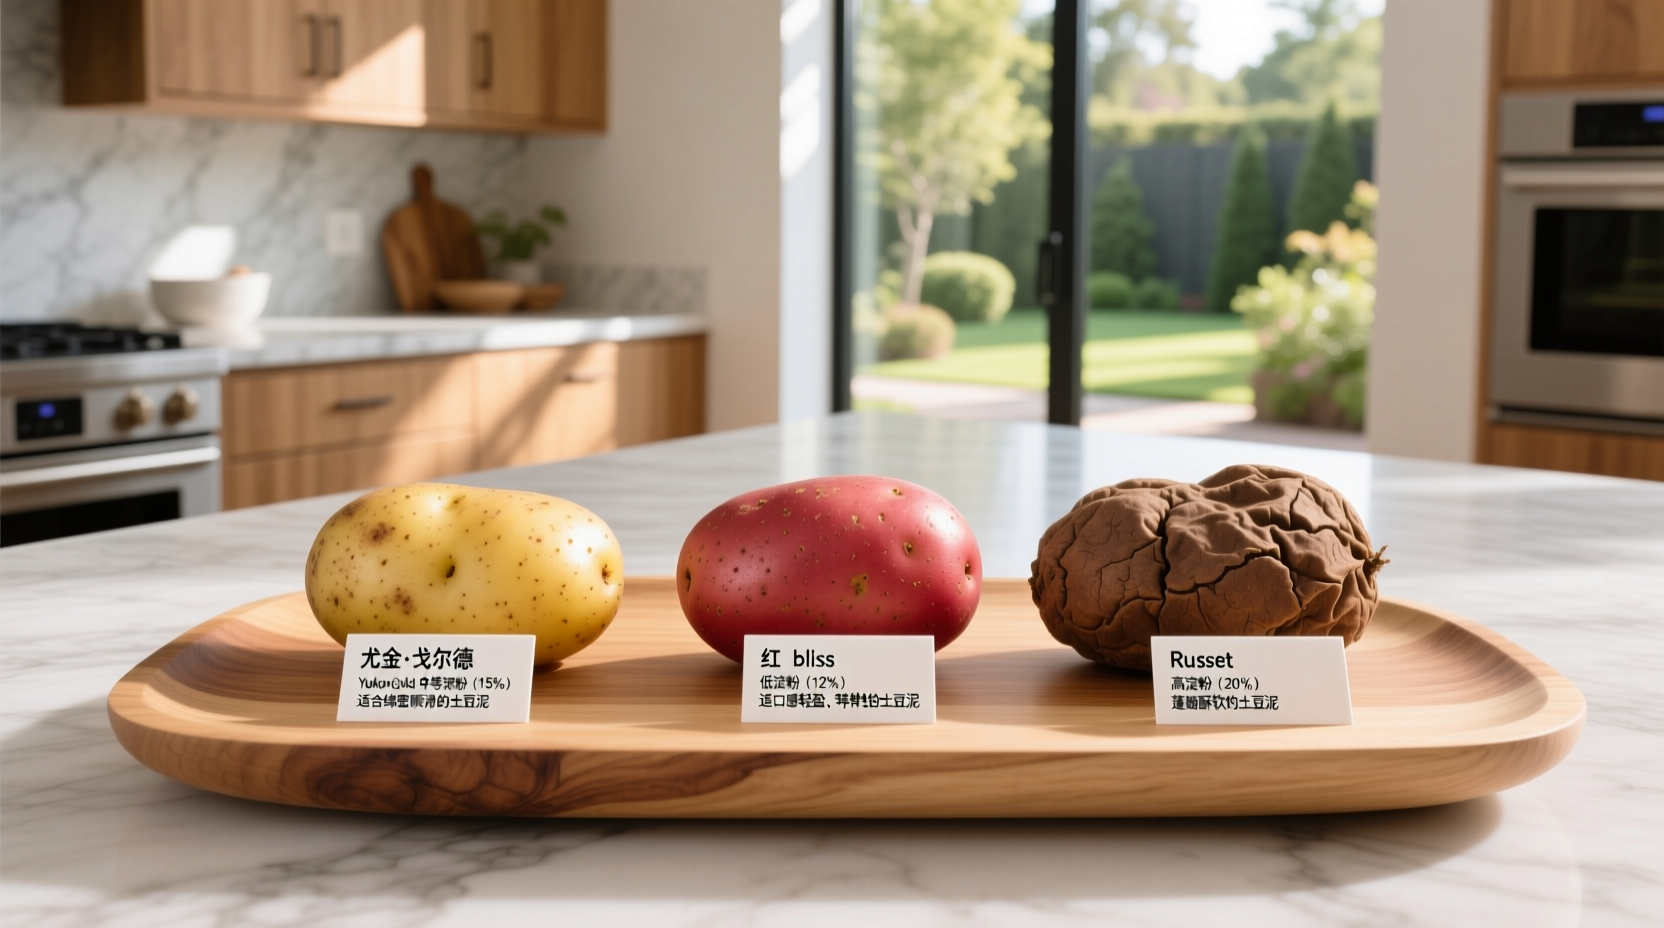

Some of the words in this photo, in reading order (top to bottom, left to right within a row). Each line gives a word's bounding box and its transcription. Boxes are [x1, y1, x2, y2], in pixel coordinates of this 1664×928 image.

[360, 646, 474, 671] 尤金·戈尔德
[761, 647, 782, 669] 红
[793, 648, 835, 668] bliss
[1170, 650, 1234, 669] Russet
[473, 676, 511, 691] (15%)
[806, 675, 846, 691] (12%)
[1218, 676, 1259, 691] (20%)
